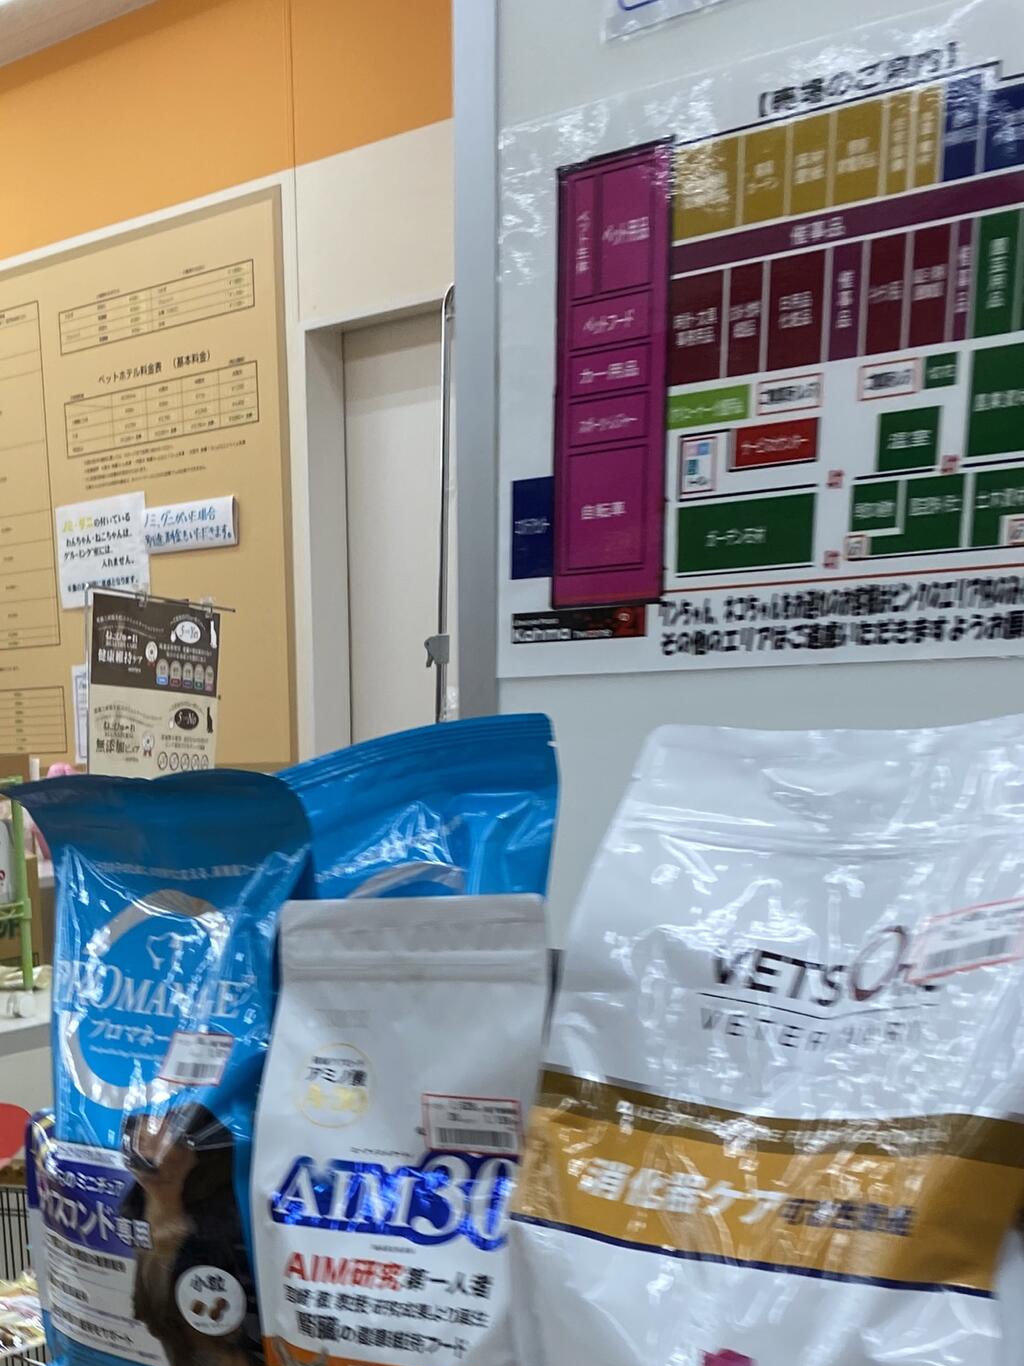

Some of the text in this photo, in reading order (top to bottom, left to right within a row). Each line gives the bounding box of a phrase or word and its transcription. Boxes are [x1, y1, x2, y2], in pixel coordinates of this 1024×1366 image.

[88, 1017, 172, 1048] プロマネー
